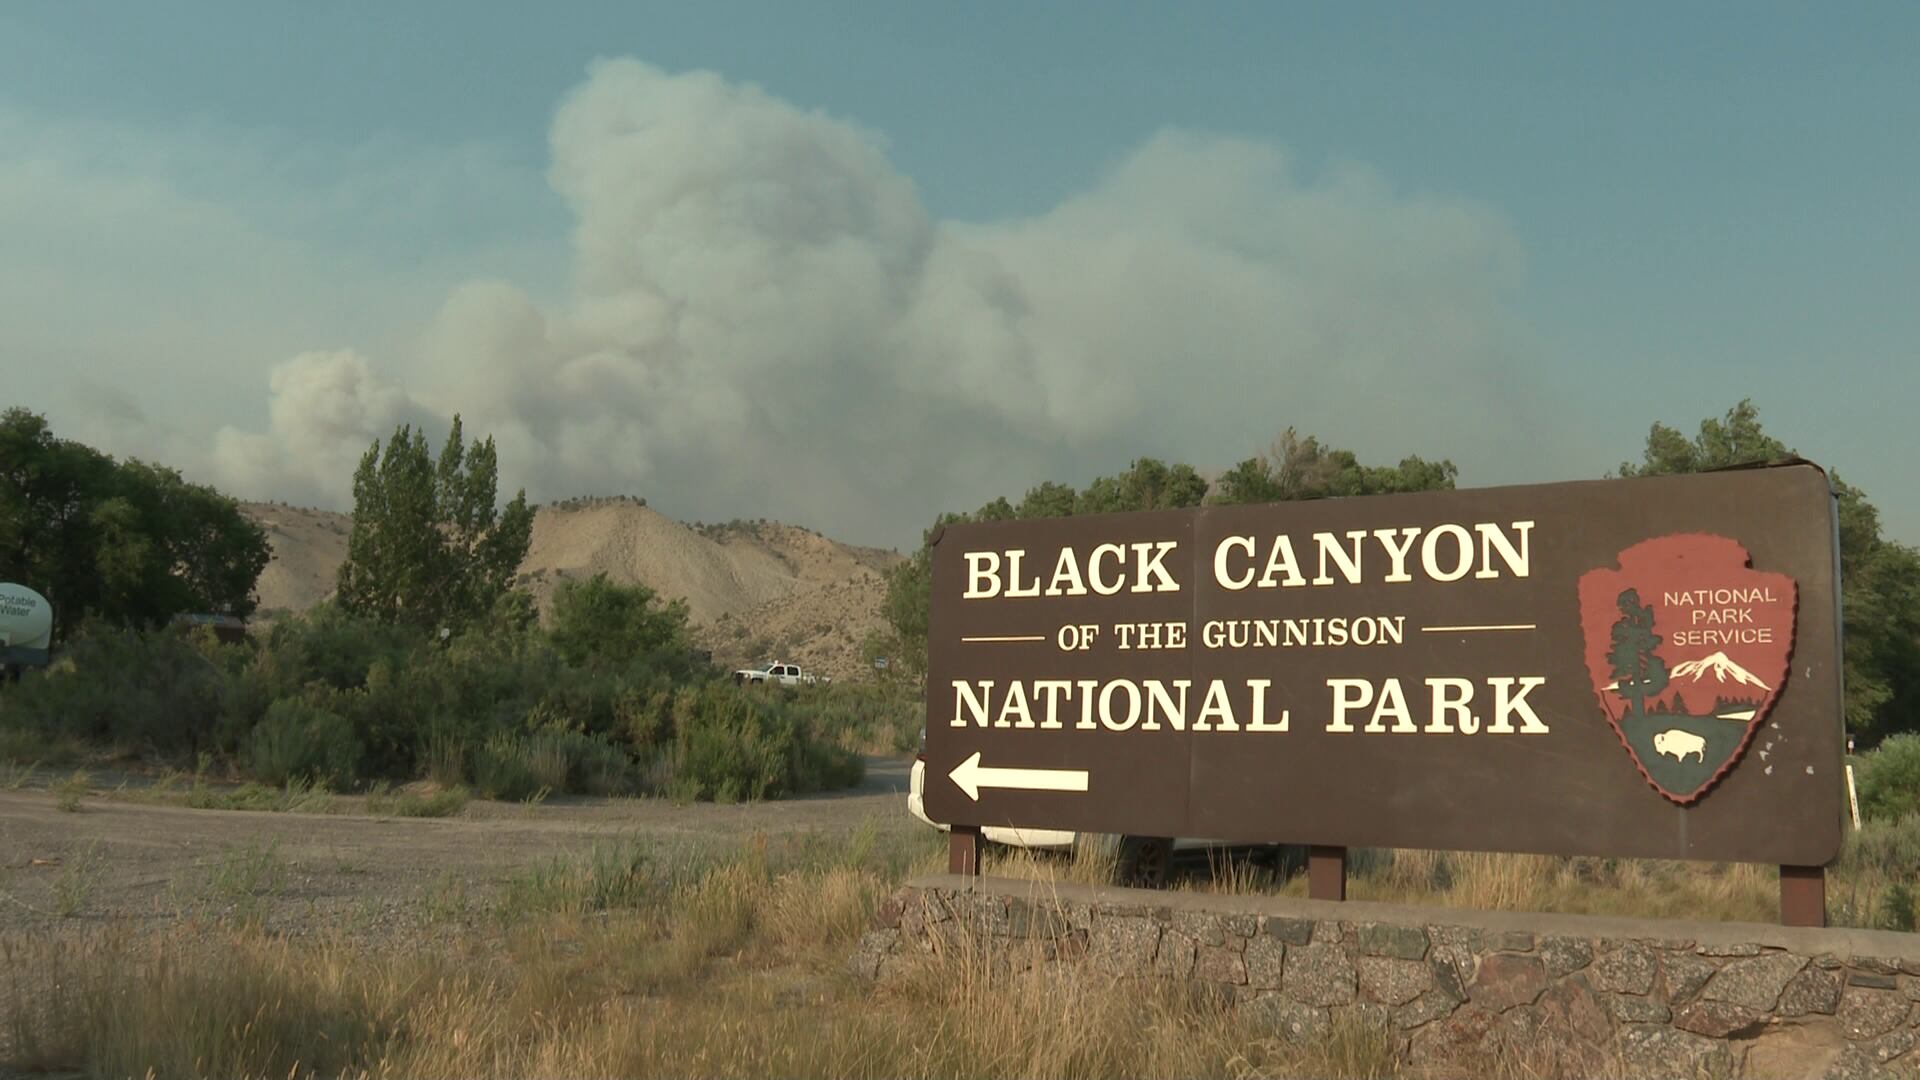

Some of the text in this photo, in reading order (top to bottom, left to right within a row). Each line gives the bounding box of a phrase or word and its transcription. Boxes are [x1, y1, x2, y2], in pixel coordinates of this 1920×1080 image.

[963, 520, 1535, 599] BLACK CANYON
[1664, 587, 1777, 606] NATIONAL
[1692, 608, 1754, 625] PARK
[1056, 615, 1406, 652] OF THE GUNNISON
[1672, 628, 1773, 646] SERVICE
[949, 676, 1551, 735] NATIONAL PARK
